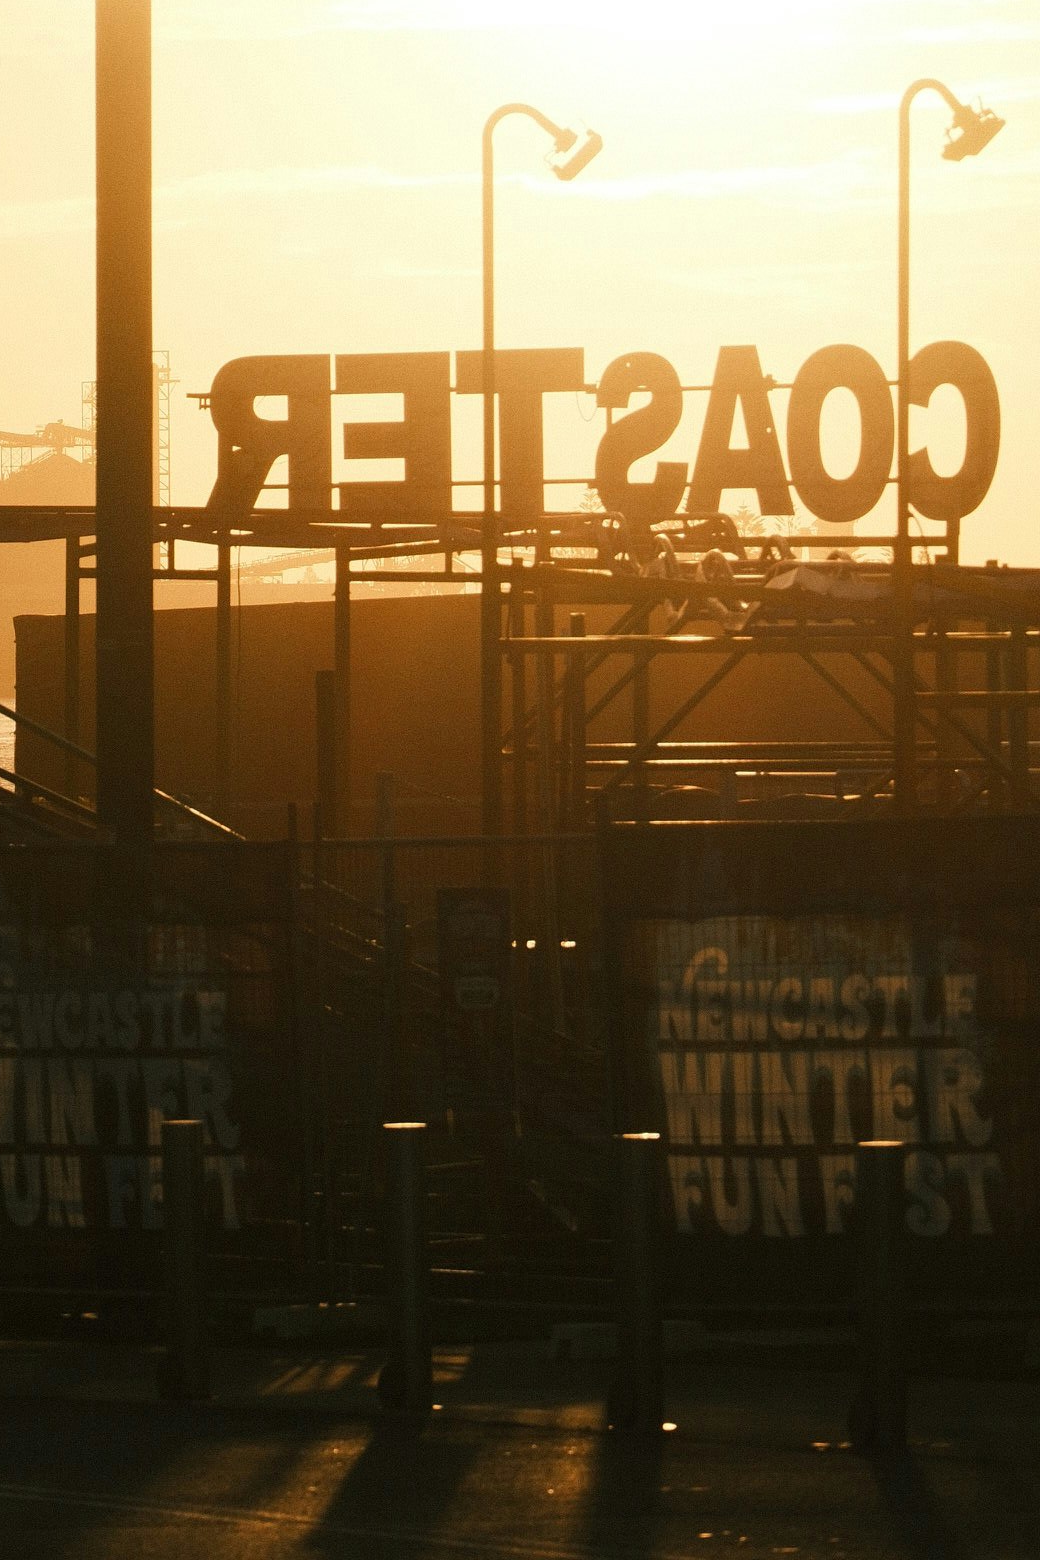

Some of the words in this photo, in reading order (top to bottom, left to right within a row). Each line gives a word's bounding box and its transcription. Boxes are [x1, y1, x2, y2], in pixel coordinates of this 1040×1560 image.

[660, 947, 978, 1042] NEWCASTLE
[660, 1046, 993, 1146] WINTER
[103, 1154, 246, 1229] FET
[667, 1152, 807, 1238] FUN
[817, 1150, 1003, 1238] FST
